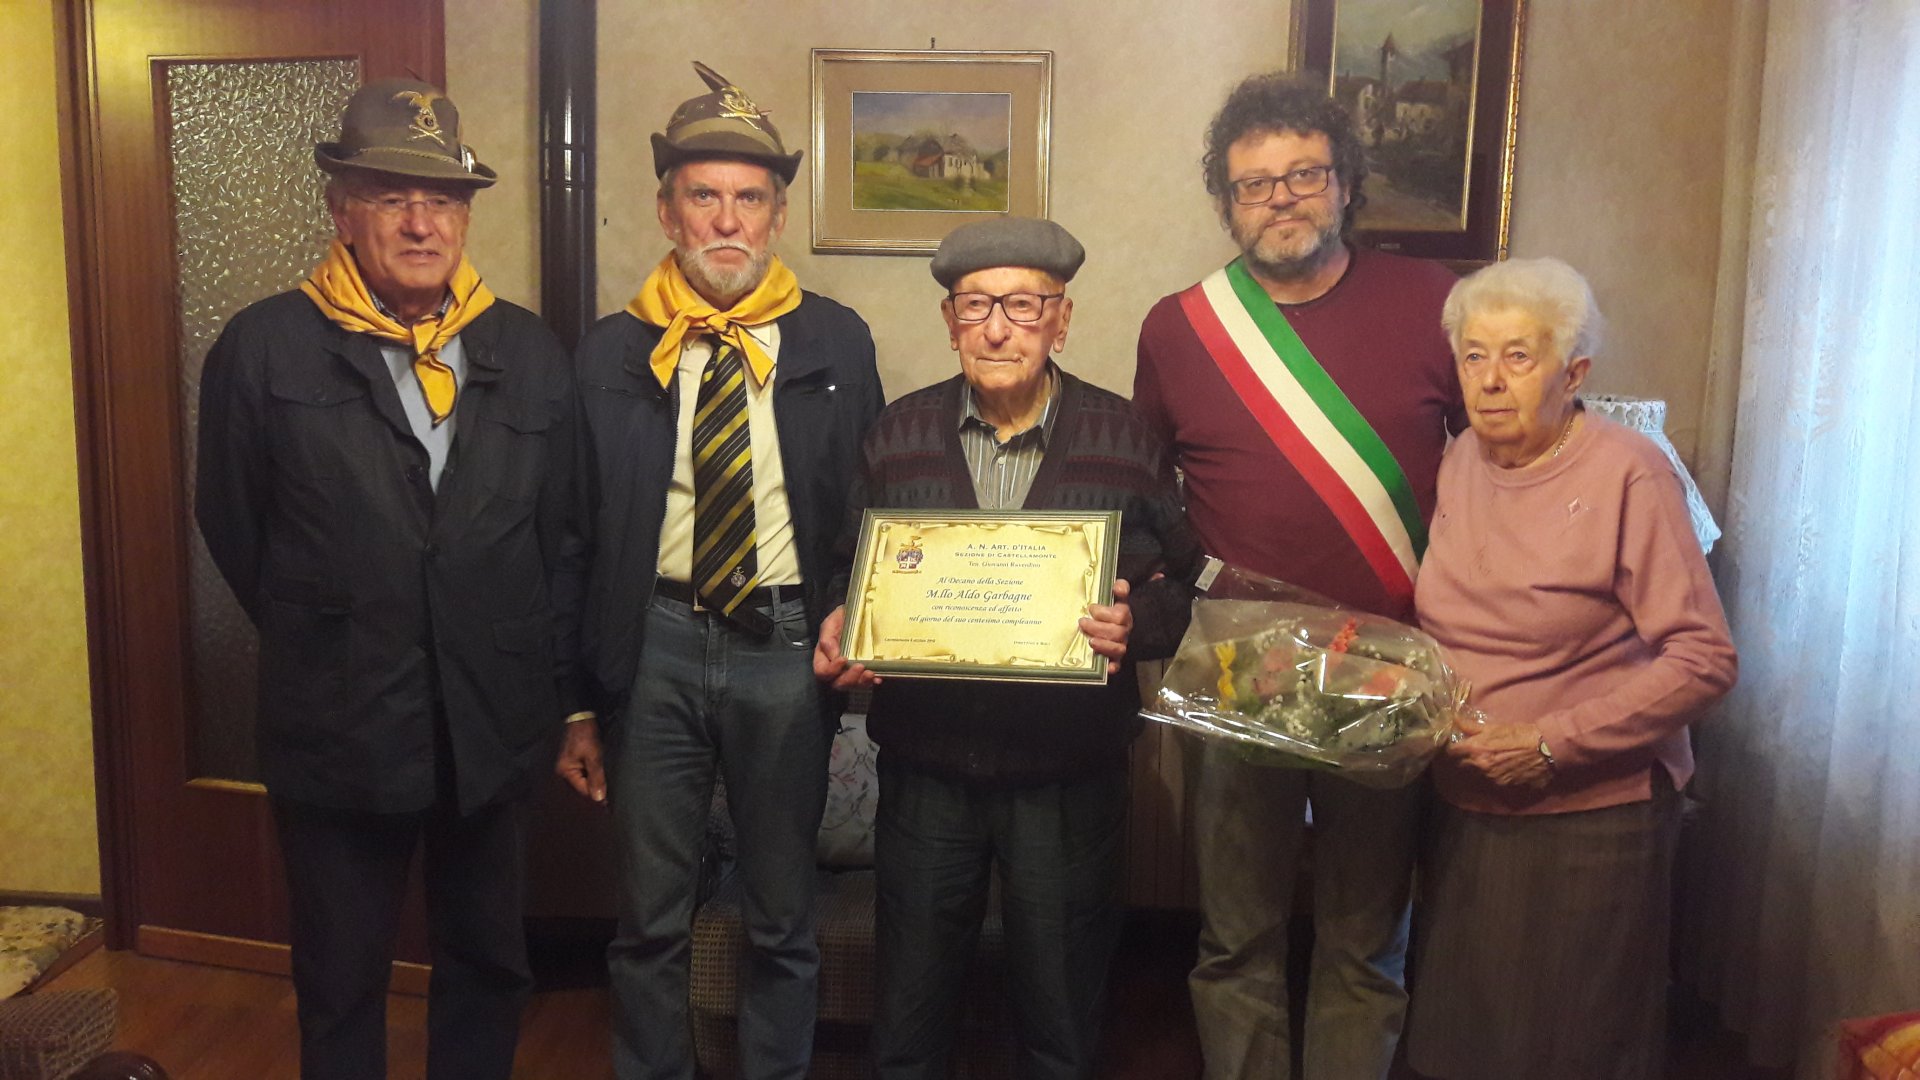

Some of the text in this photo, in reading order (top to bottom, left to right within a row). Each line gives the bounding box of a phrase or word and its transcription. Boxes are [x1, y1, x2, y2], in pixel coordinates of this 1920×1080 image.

[947, 577, 976, 585] Decano
[976, 577, 994, 585] della
[995, 578, 1024, 586] Sezione
[926, 588, 953, 599] M.llo
[954, 588, 980, 600] Aldo
[944, 604, 987, 612] riconoscenza
[998, 605, 1022, 613] affetto
[919, 616, 942, 624] giorno
[942, 615, 954, 623] del
[1001, 618, 1043, 626] compleanno
